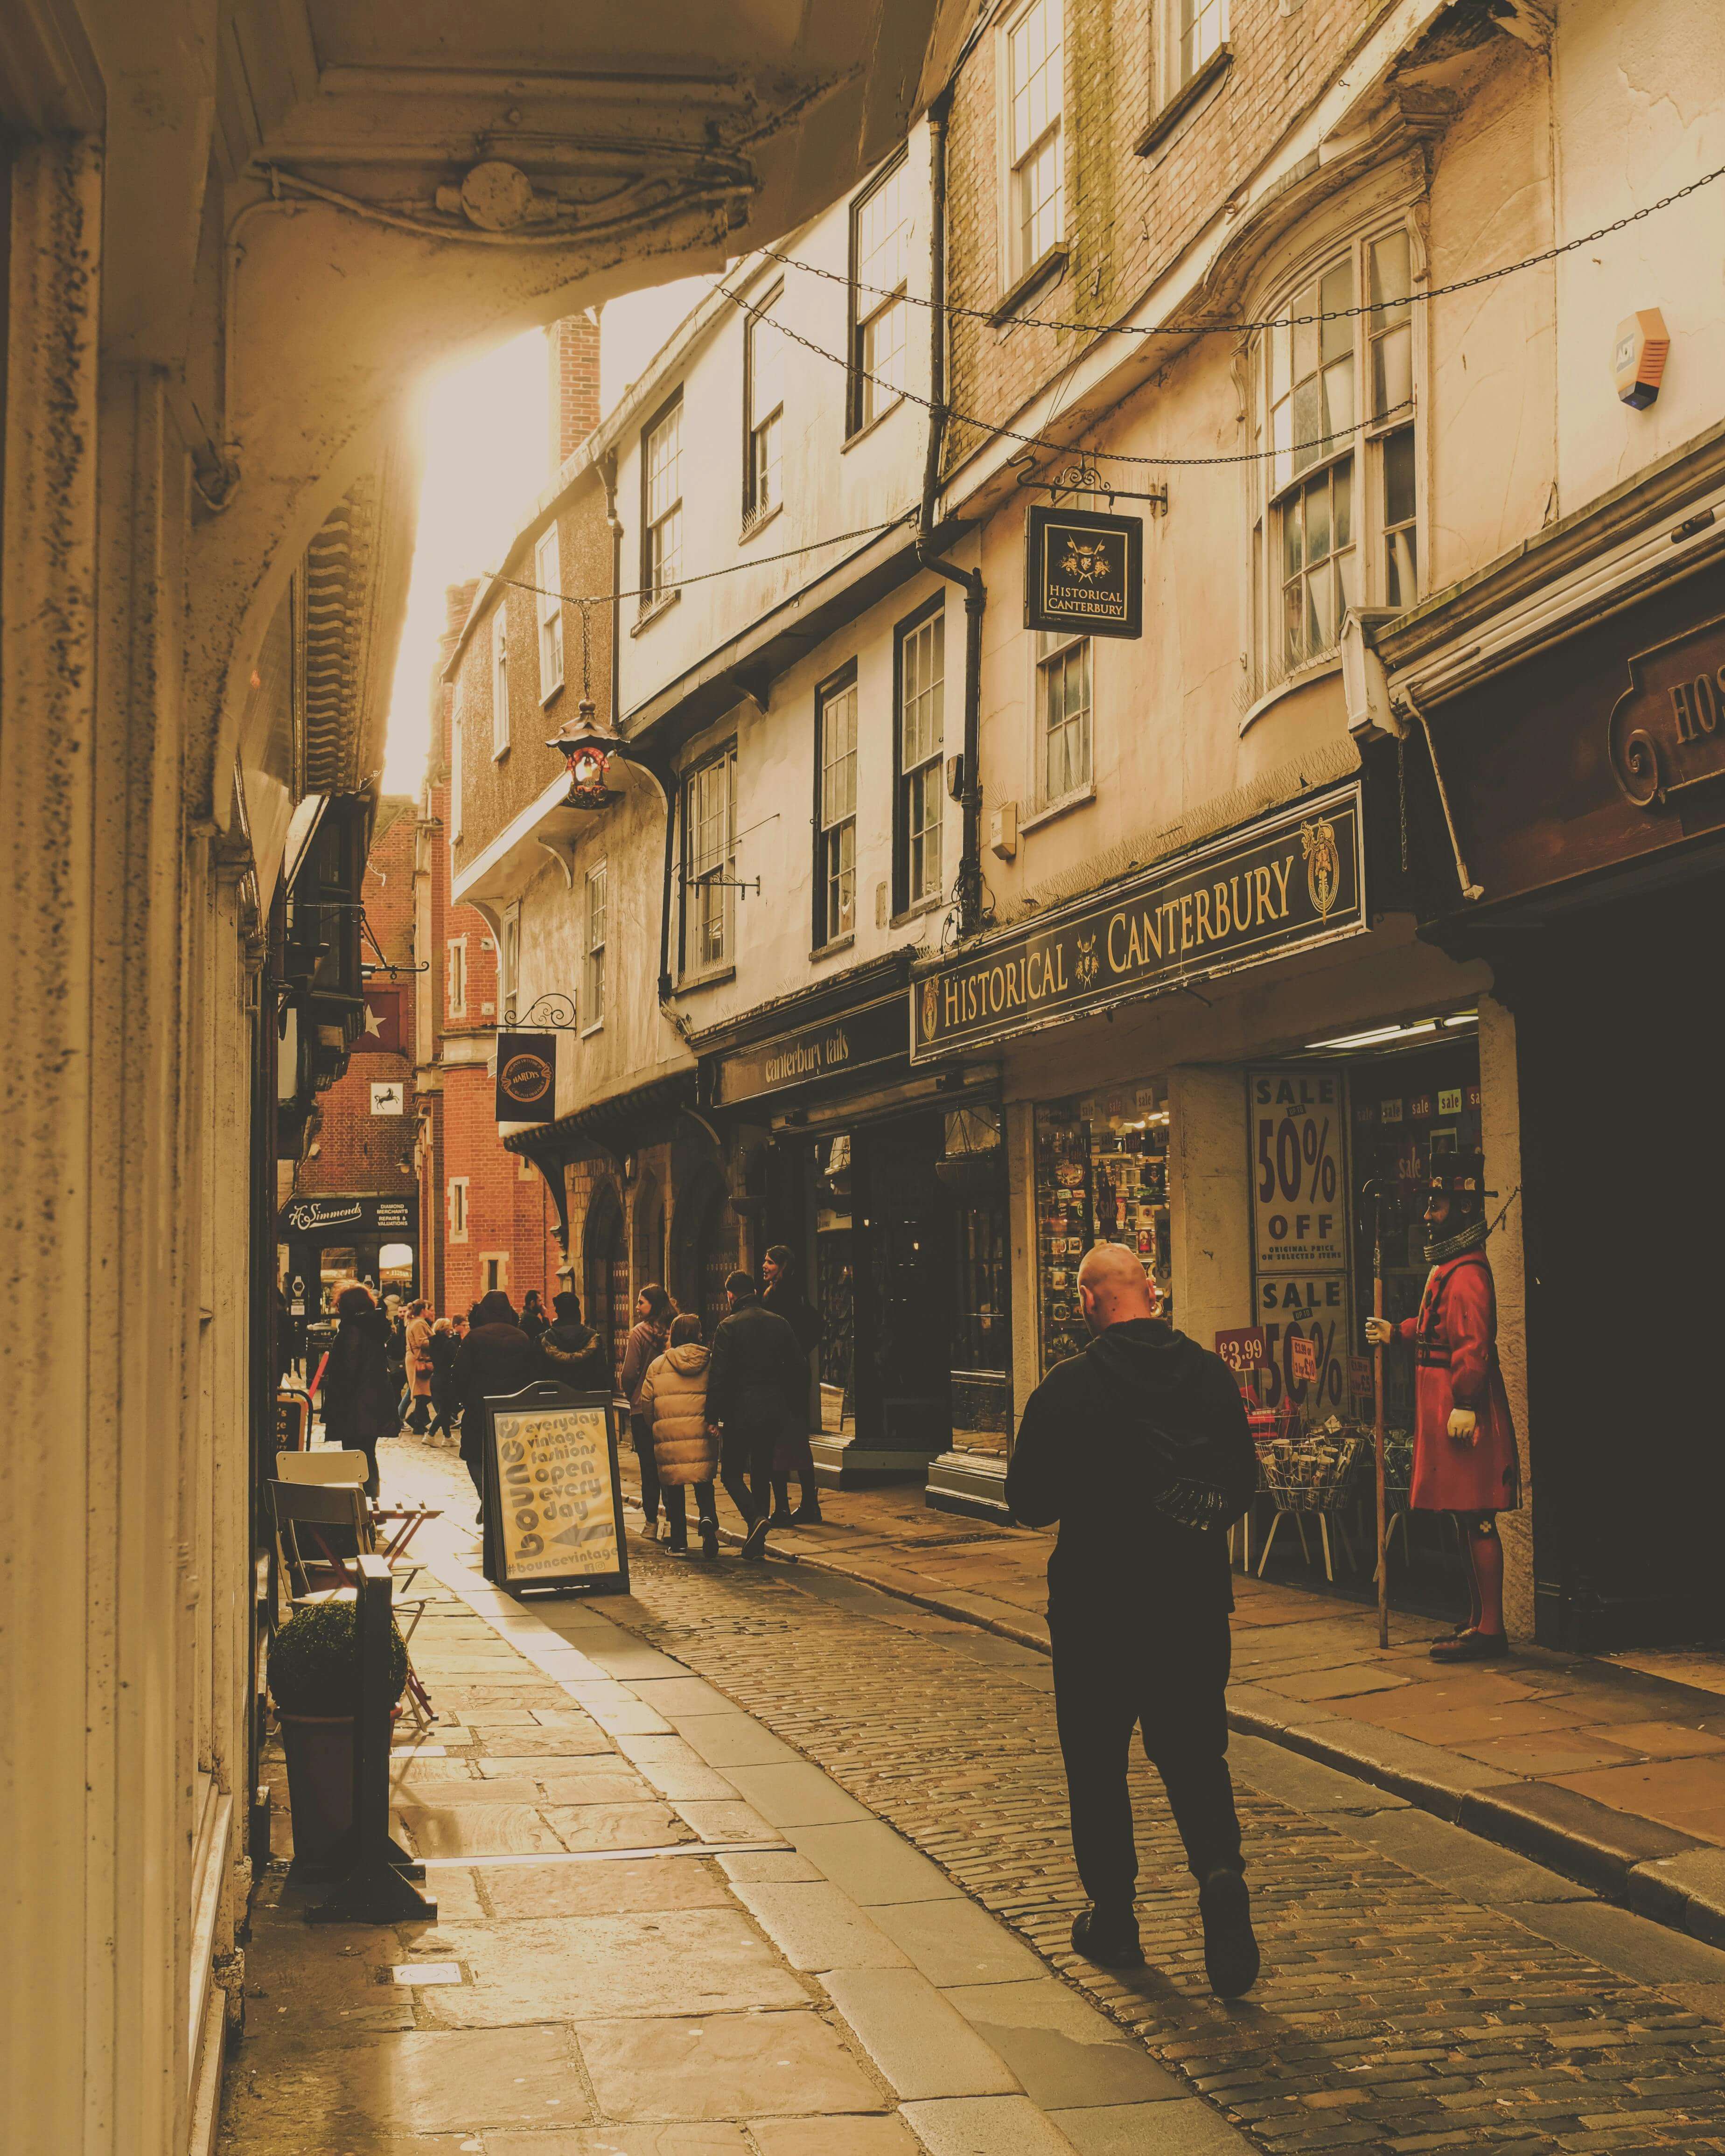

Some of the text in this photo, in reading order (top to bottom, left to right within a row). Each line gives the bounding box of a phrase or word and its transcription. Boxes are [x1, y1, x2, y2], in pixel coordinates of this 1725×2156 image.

[1049, 585, 1122, 602] HISTORICAL
[1048, 598, 1123, 615] CANTERBURY
[944, 855, 1294, 1027] HISTORICAL CANTERBURY
[765, 1027, 849, 1083] canterbury tails
[513, 1071, 539, 1083] HARDYS
[1139, 1095, 1151, 1106] sale
[1257, 1080, 1333, 1104] SALE
[1442, 1095, 1459, 1109] sale
[1082, 1105, 1093, 1116] sale
[1109, 1098, 1121, 1112] sale
[1412, 1099, 1428, 1115] sale
[1259, 1117, 1336, 1204] 50%
[1399, 1147, 1421, 1179] sale
[304, 1202, 362, 1223] Simmonds
[1268, 1214, 1334, 1240] OFF
[1263, 1282, 1341, 1309] SALE
[1219, 1339, 1262, 1369] £3.99
[1305, 1358, 1314, 1377] £10
[525, 1411, 600, 1434] everyday
[527, 1430, 586, 1448] vintage
[531, 1443, 596, 1464] fashions
[535, 1460, 594, 1485] open
[497, 1417, 544, 1560] bounce
[539, 1477, 602, 1501] every
[543, 1500, 588, 1521] day
[507, 1546, 618, 1575] #bouncevintage
